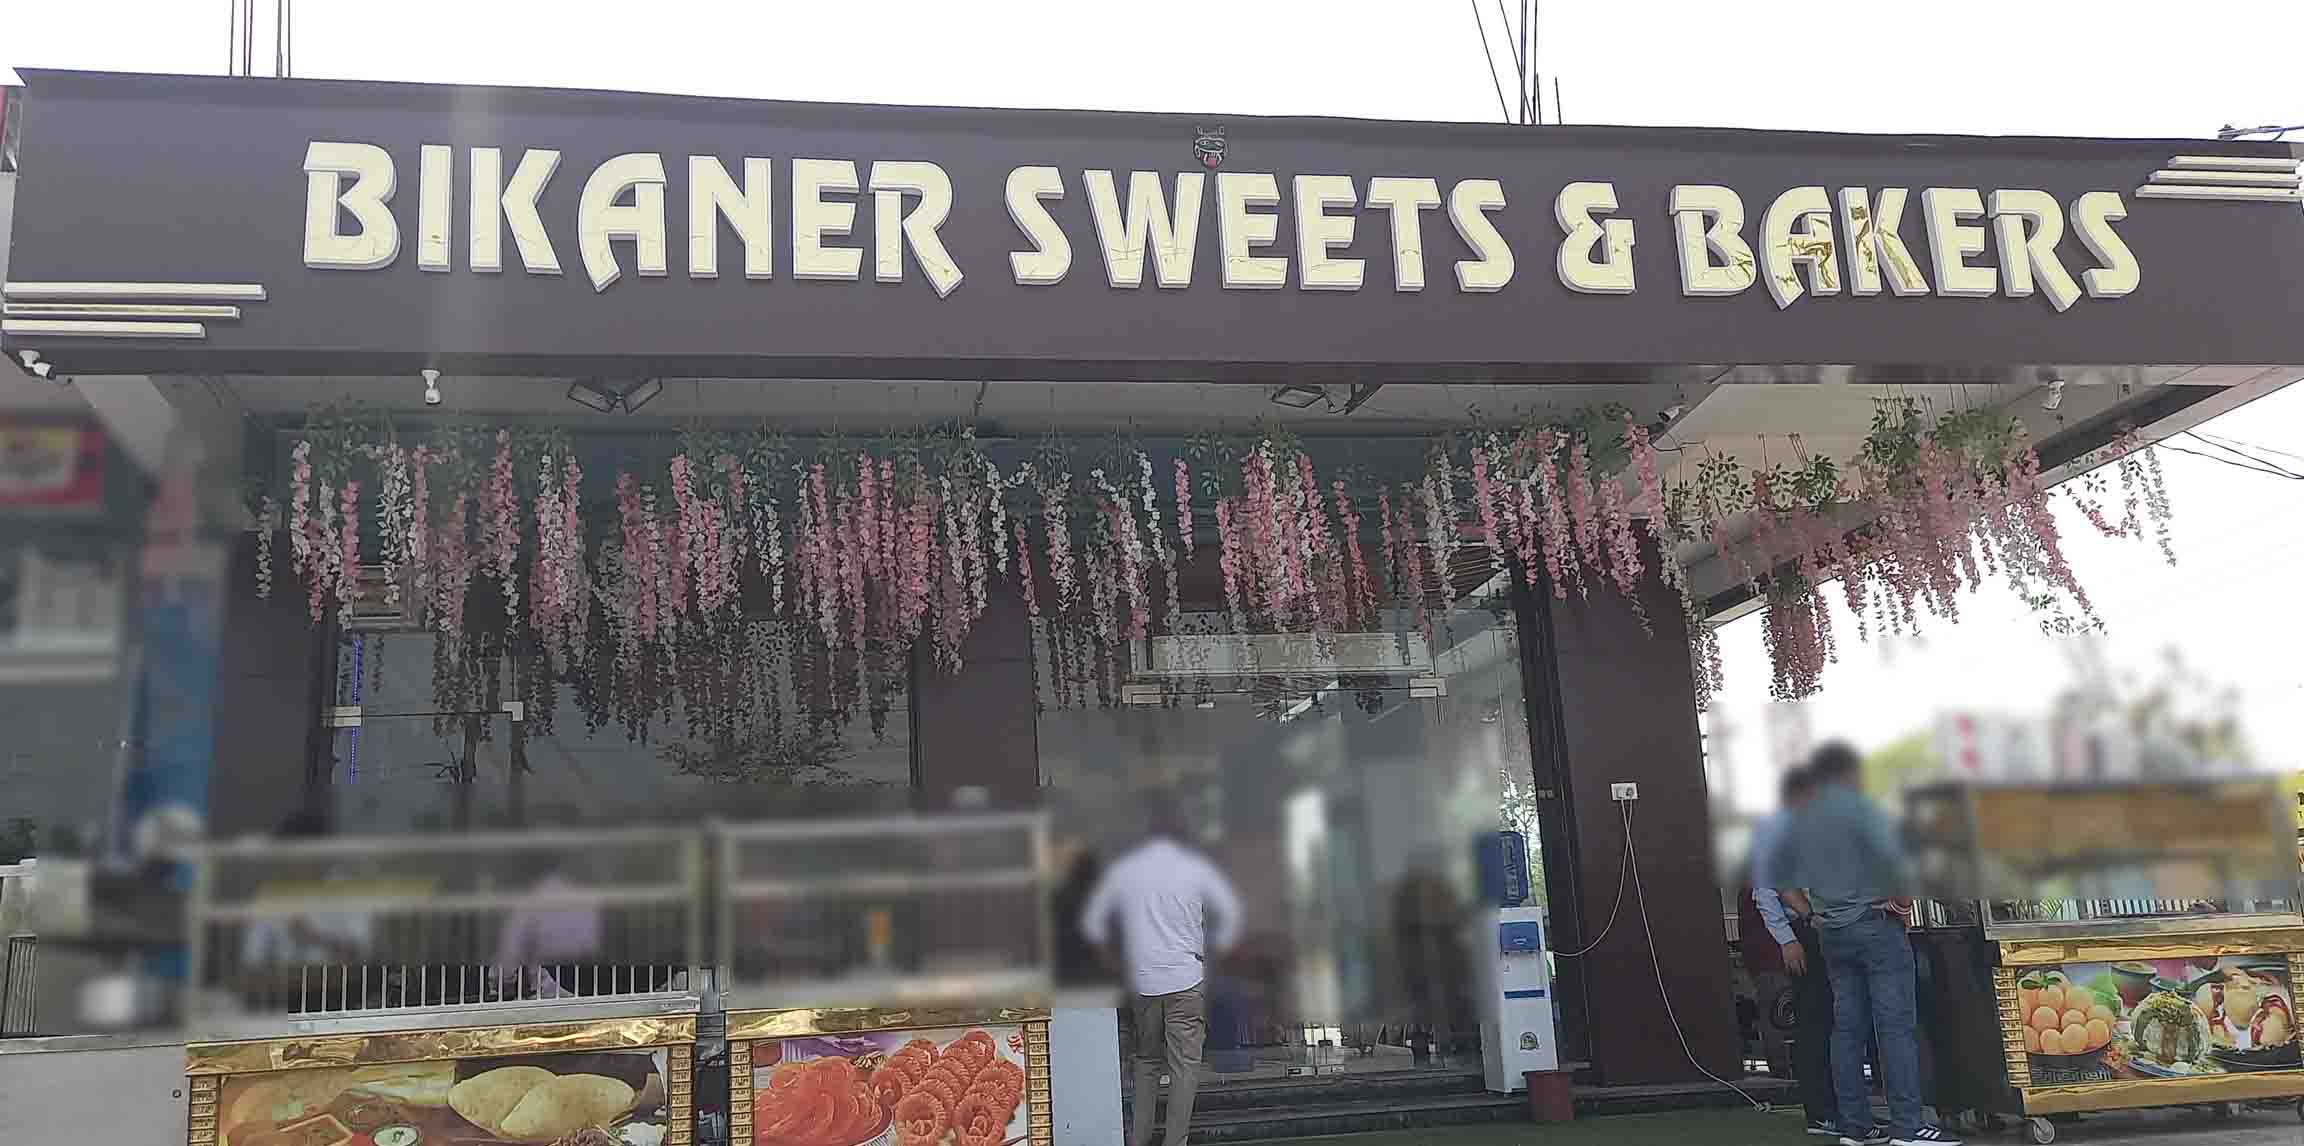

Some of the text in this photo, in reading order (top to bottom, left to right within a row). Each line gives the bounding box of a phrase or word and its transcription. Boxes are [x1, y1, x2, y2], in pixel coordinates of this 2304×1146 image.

[303, 141, 2142, 312] BIKANER SWEETS & BAKERS
